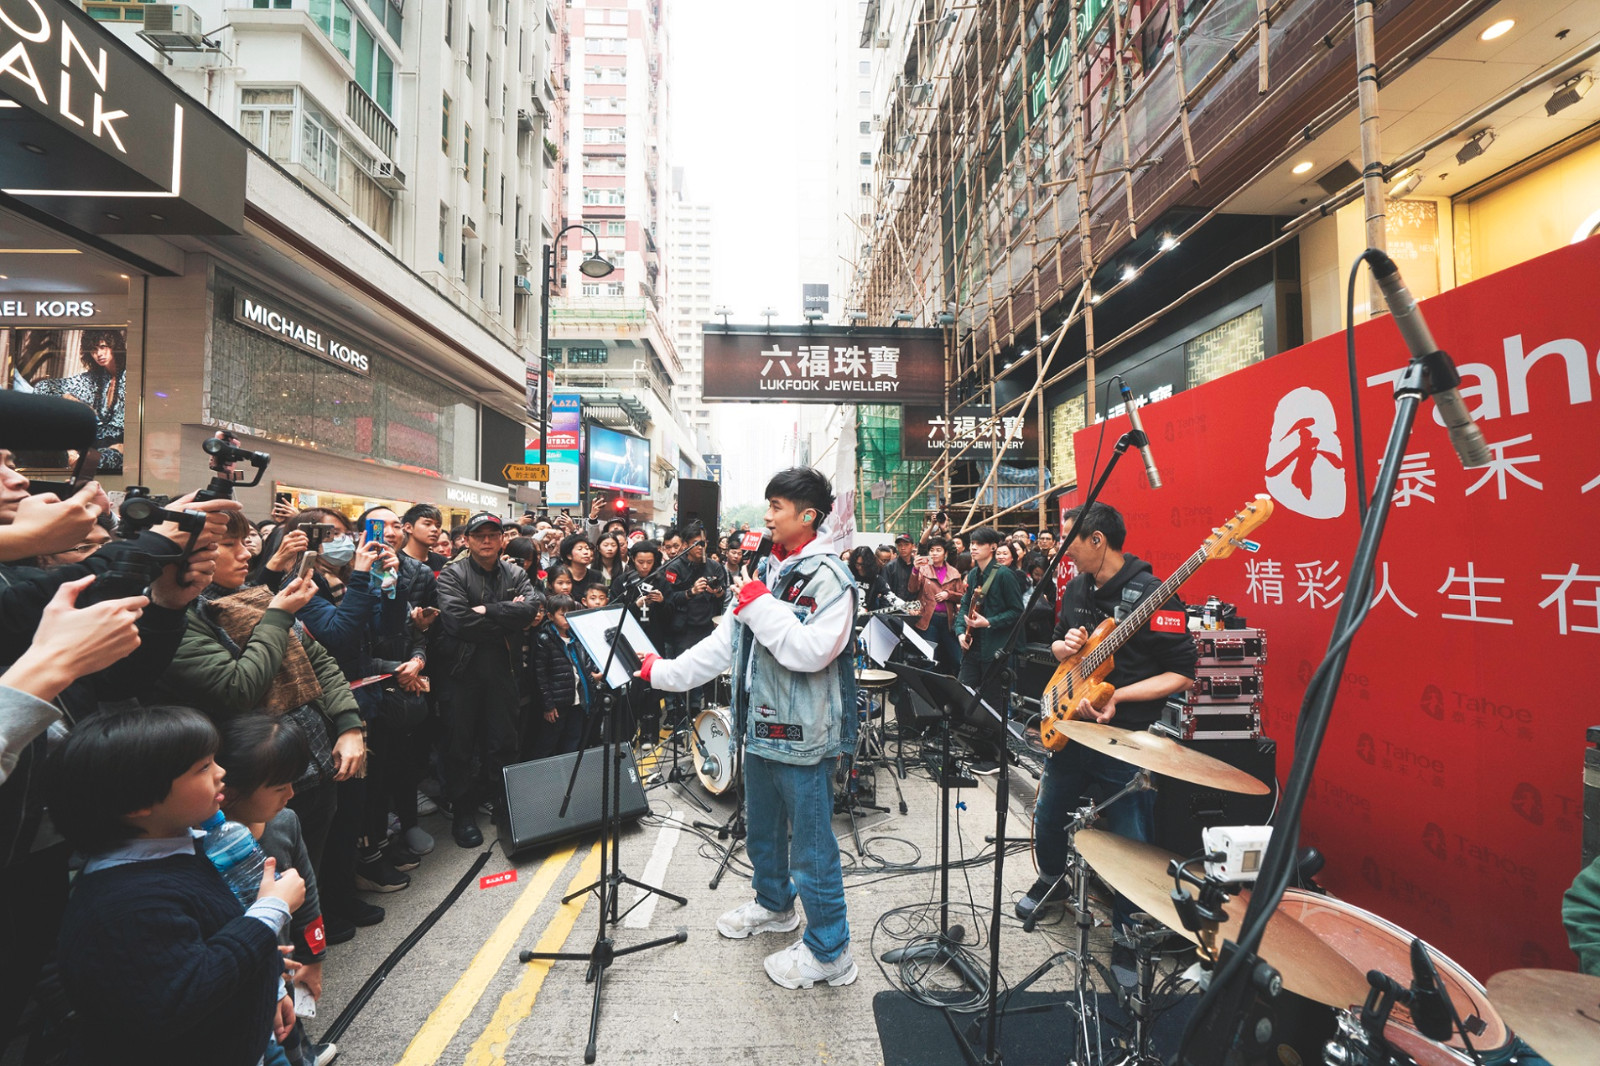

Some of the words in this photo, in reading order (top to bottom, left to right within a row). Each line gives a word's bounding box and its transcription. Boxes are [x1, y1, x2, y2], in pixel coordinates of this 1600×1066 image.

[36, 301, 94, 317] KORS
[245, 299, 325, 352] MICHAEL
[329, 340, 369, 371] KORS
[760, 344, 900, 379] 六福珠寶
[760, 380, 820, 391] LUKFOOK
[825, 381, 900, 392] JEWELLERY
[446, 487, 479, 505] MICHAEL
[480, 494, 498, 507] KORS
[1452, 690, 1533, 724] Tahoe
[1381, 739, 1445, 774] Tahoe
